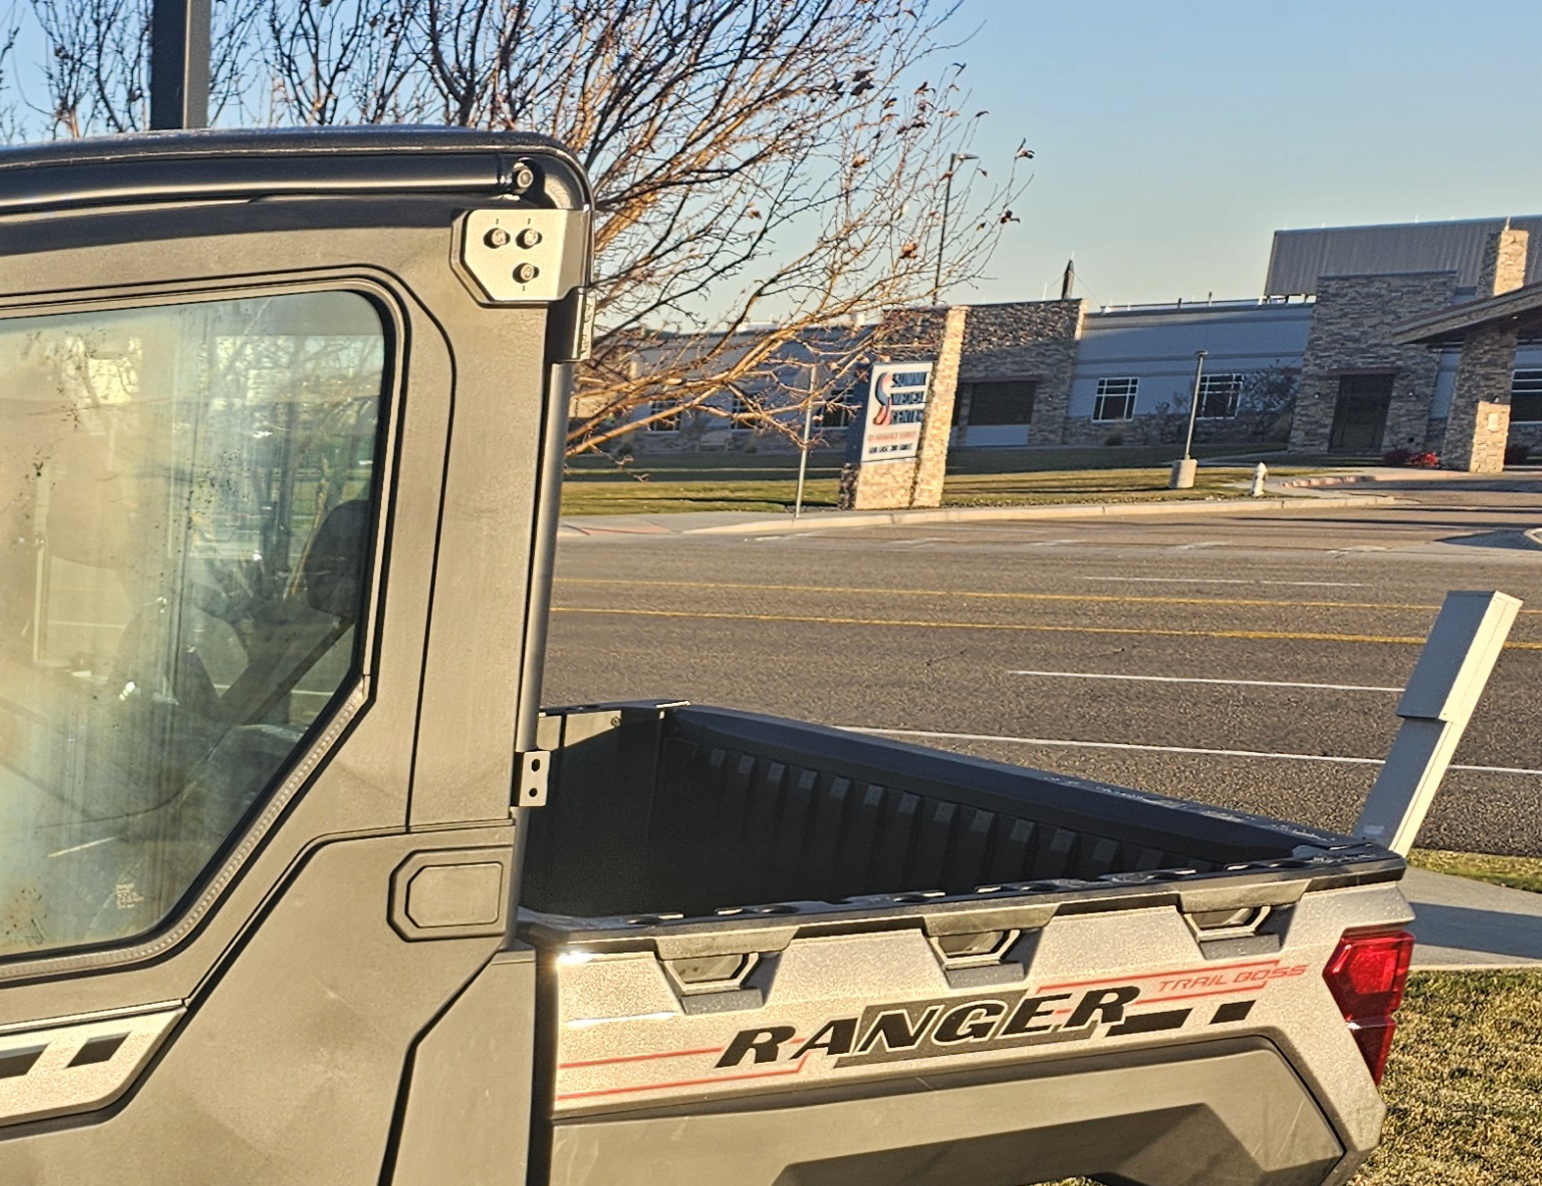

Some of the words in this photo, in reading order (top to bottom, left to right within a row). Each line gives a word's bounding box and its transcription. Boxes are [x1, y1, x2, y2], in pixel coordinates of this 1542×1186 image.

[1159, 974, 1228, 992] TRAIL
[1233, 964, 1308, 984] BOSS
[714, 985, 1142, 1069] RANGER
